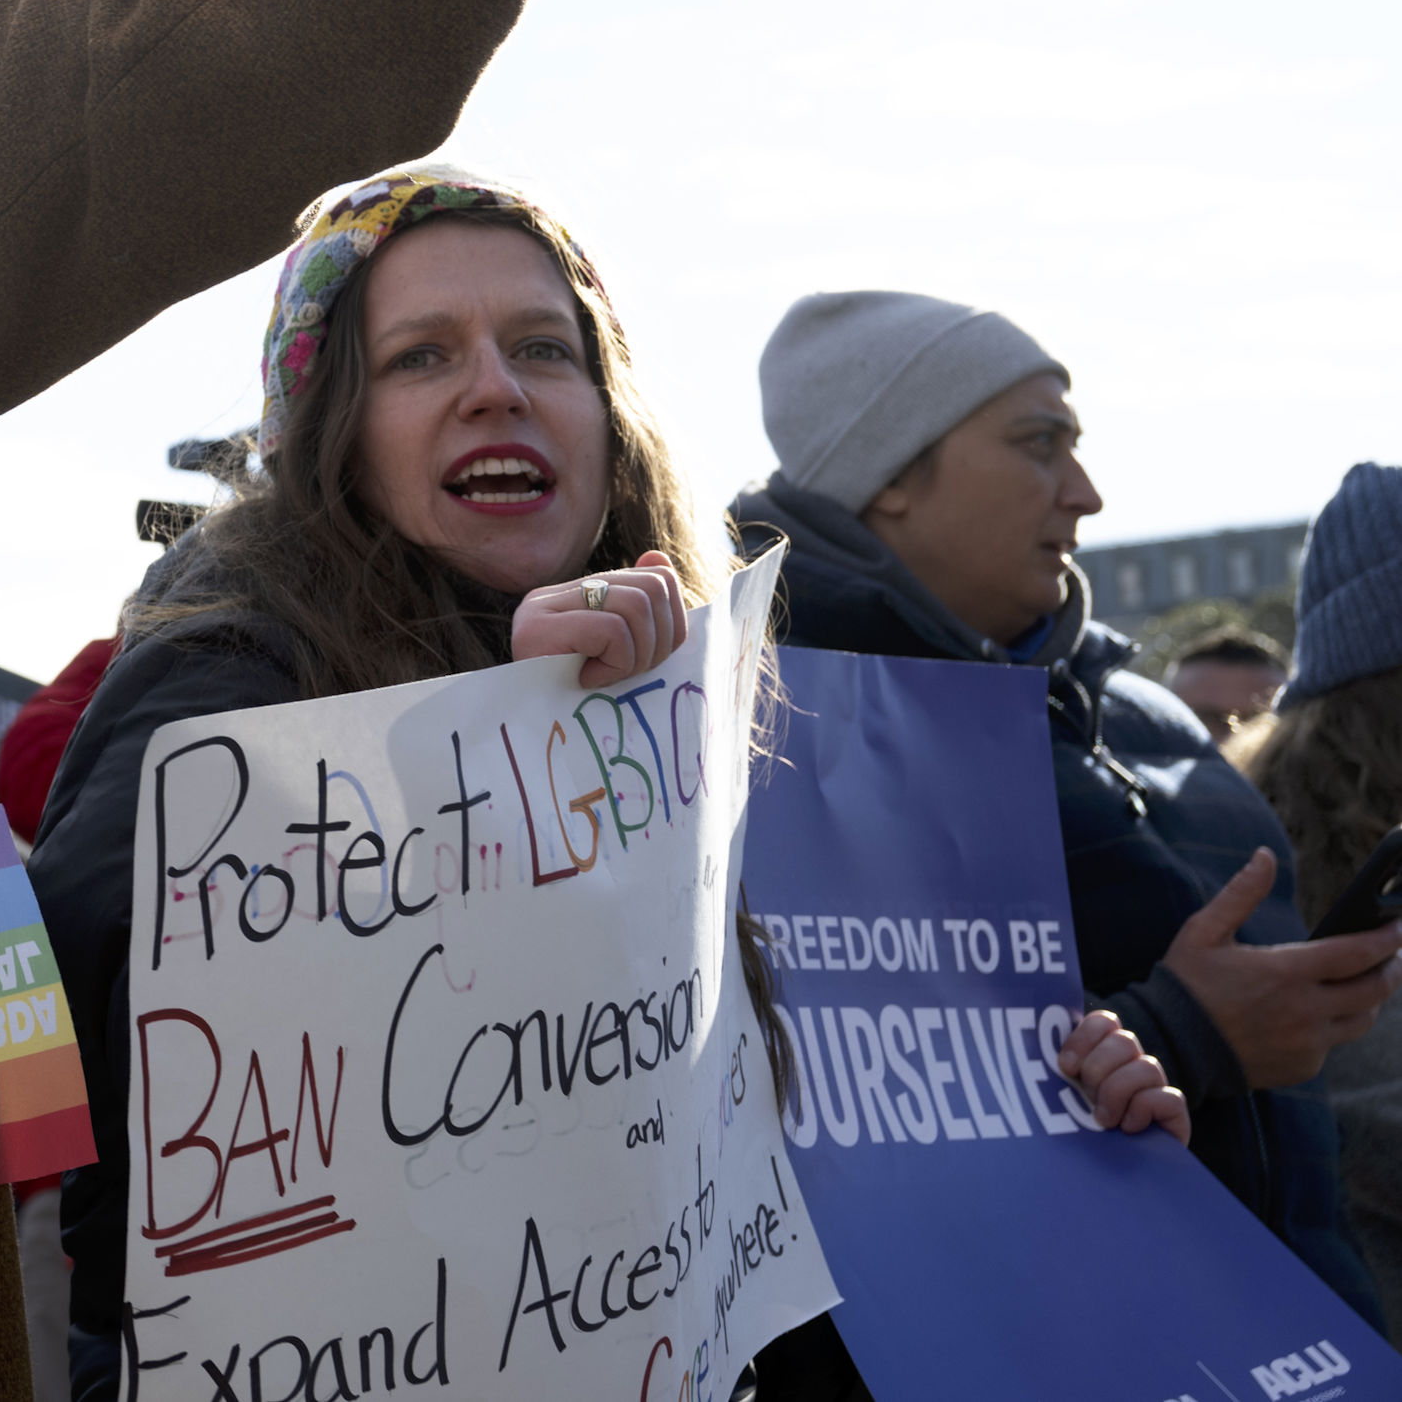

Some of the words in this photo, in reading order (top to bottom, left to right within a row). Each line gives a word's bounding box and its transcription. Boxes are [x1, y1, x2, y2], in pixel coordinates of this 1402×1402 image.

[152, 730, 492, 971] Protect
[499, 678, 710, 887] LGBTQ
[943, 918, 1000, 974] TO
[1008, 920, 1066, 974] BE
[137, 1007, 343, 1239] BAN
[382, 943, 703, 1146] Conversion
[626, 1098, 665, 1149] and
[499, 1206, 693, 1373] Access
[1249, 1339, 1352, 1402] ACLU
